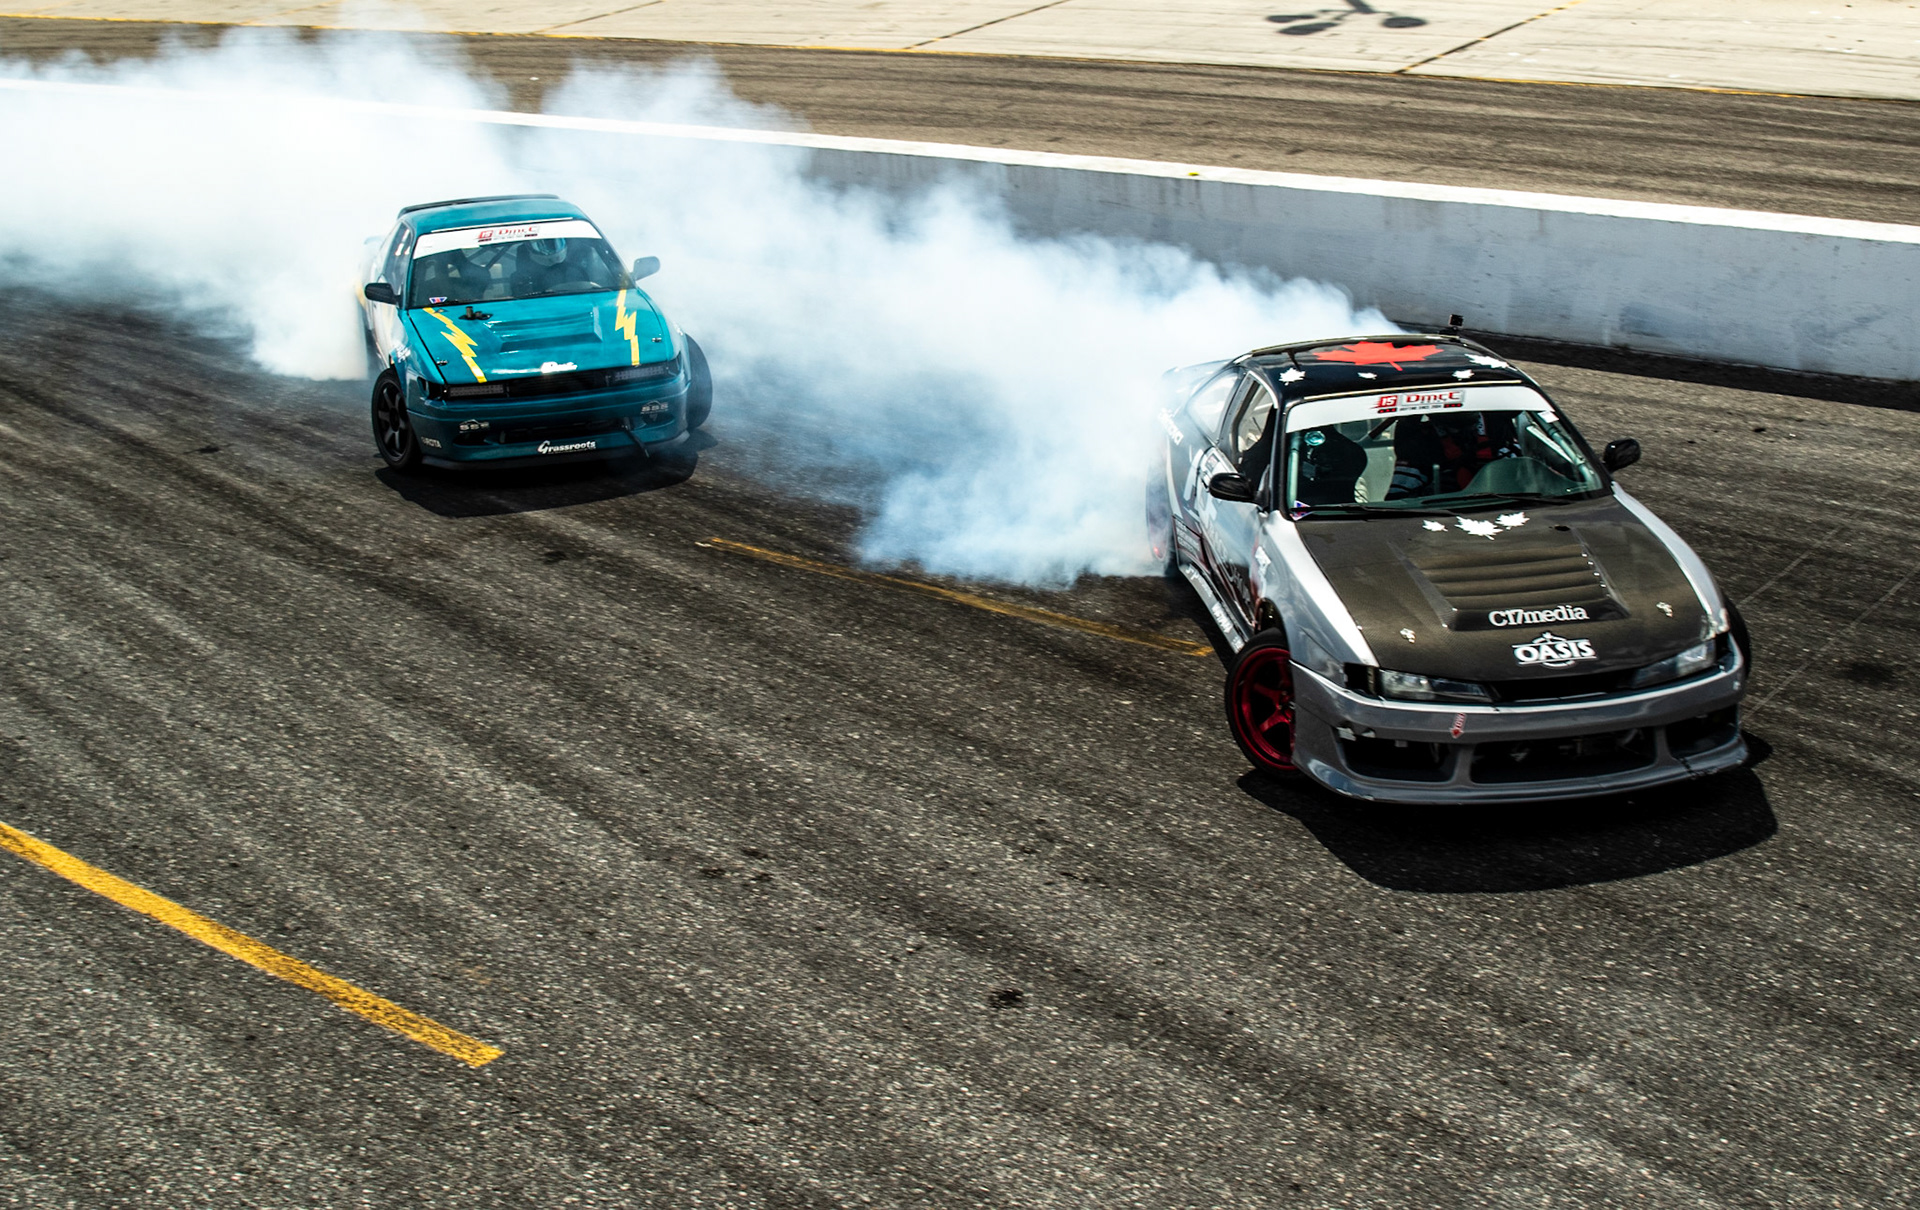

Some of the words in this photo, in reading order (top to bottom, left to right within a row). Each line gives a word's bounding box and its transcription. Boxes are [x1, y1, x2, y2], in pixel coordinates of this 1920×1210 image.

[1380, 395, 1398, 407] 15
[538, 439, 596, 454] Grassroots
[1488, 605, 1590, 627] C17media
[1513, 641, 1596, 662] OASIS
